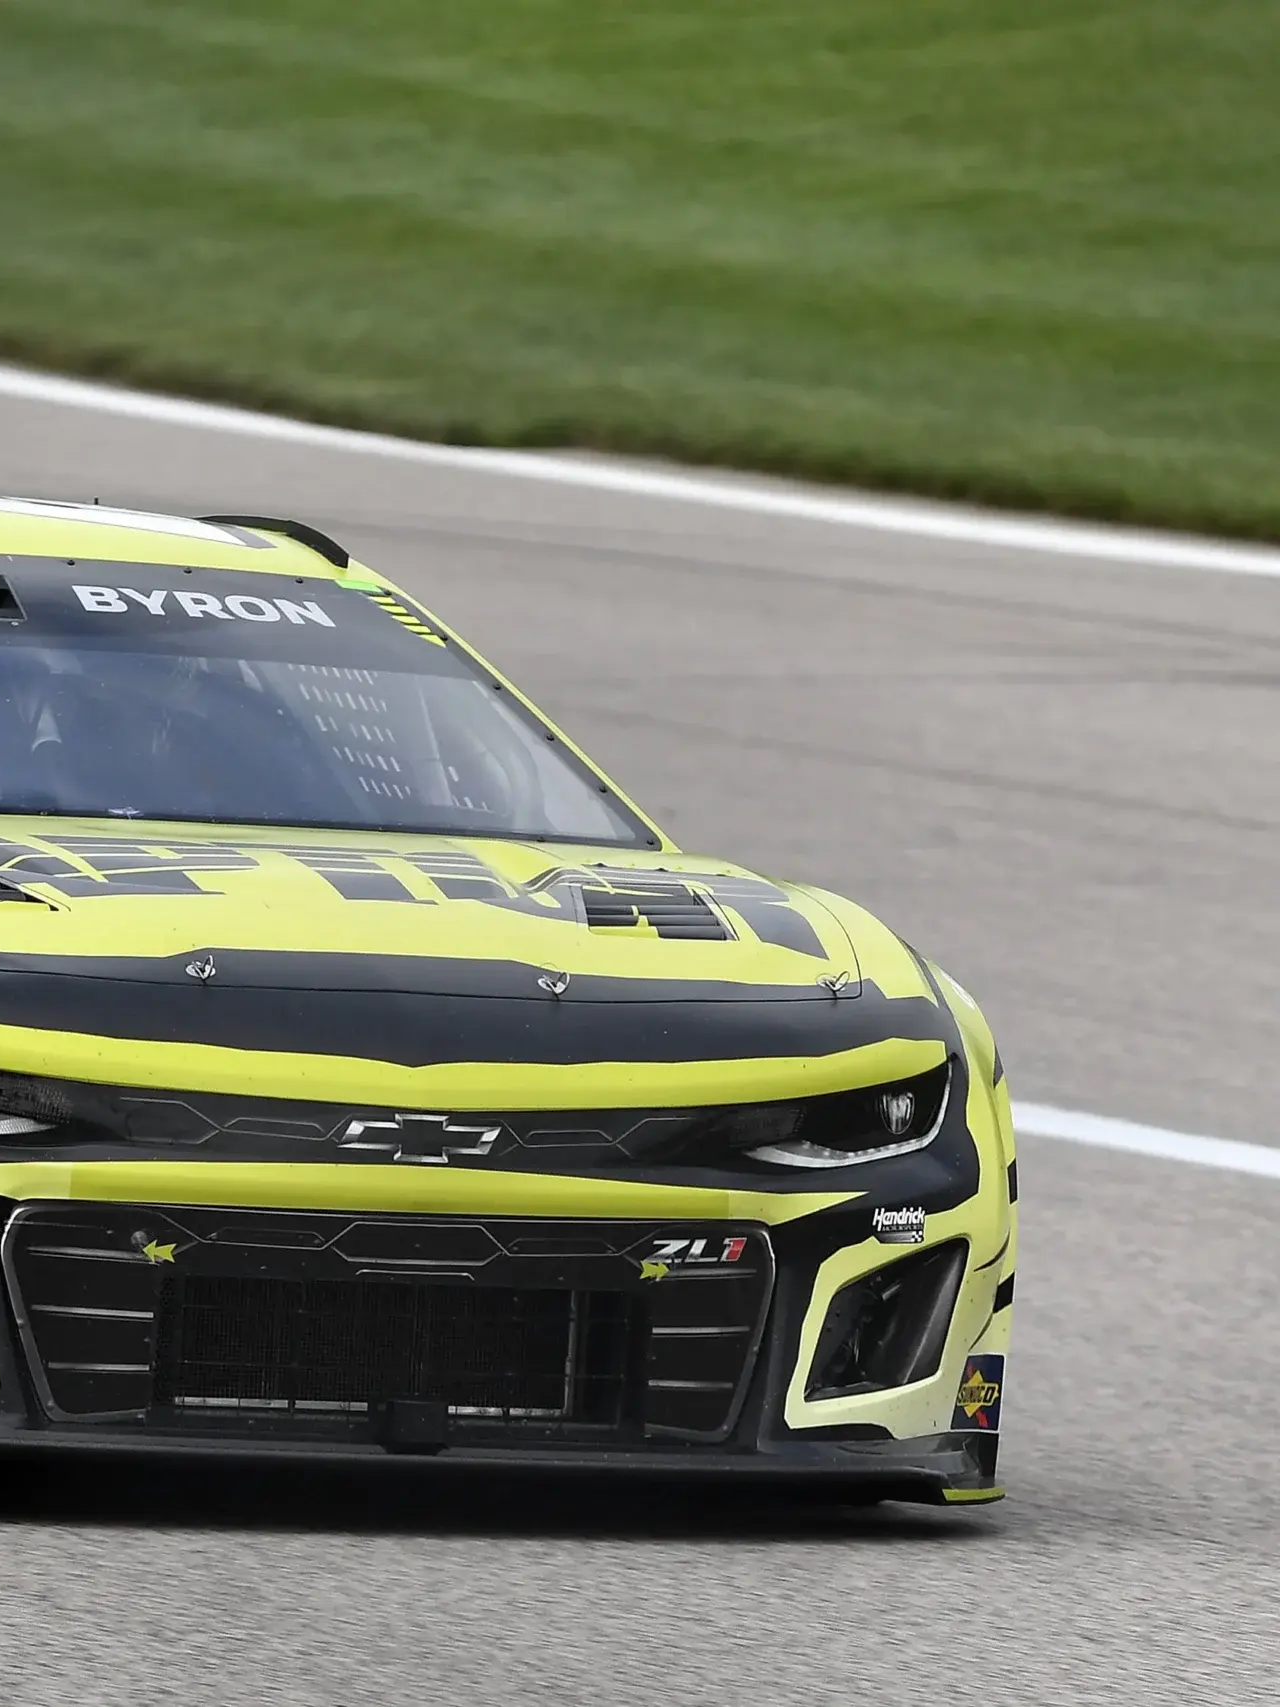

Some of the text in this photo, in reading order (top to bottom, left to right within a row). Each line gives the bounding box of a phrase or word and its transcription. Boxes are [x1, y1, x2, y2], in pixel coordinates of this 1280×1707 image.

[72, 585, 337, 628] BYRON
[872, 1206, 926, 1232] Hendrick
[644, 1237, 748, 1264] ZL1
